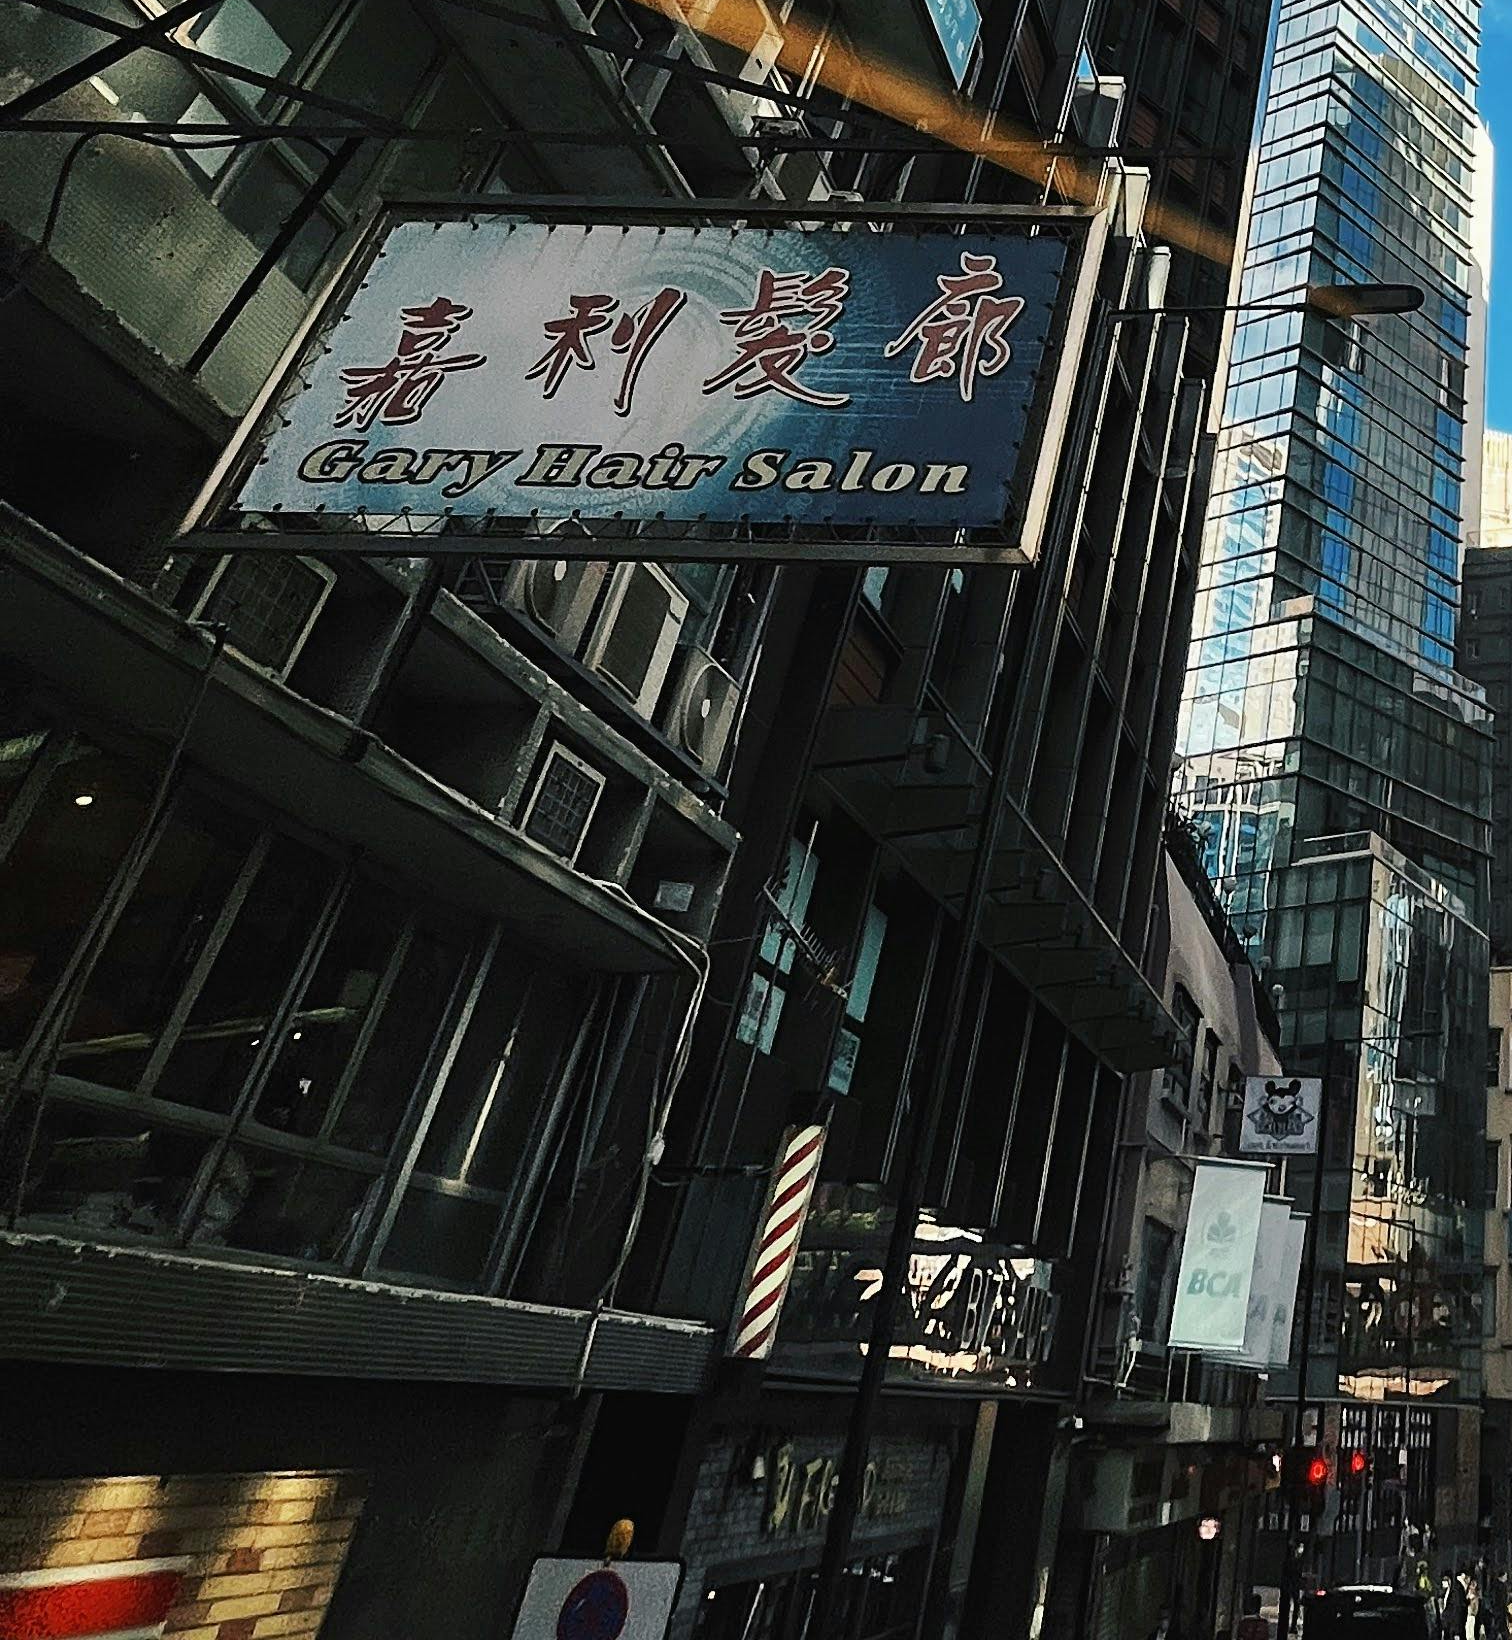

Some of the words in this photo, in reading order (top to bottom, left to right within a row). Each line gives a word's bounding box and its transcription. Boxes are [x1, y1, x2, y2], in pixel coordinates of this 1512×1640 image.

[333, 252, 1024, 433] 嘉利髮廊
[298, 438, 514, 498] Gary
[515, 441, 728, 493] Hair
[732, 448, 971, 495] Salon
